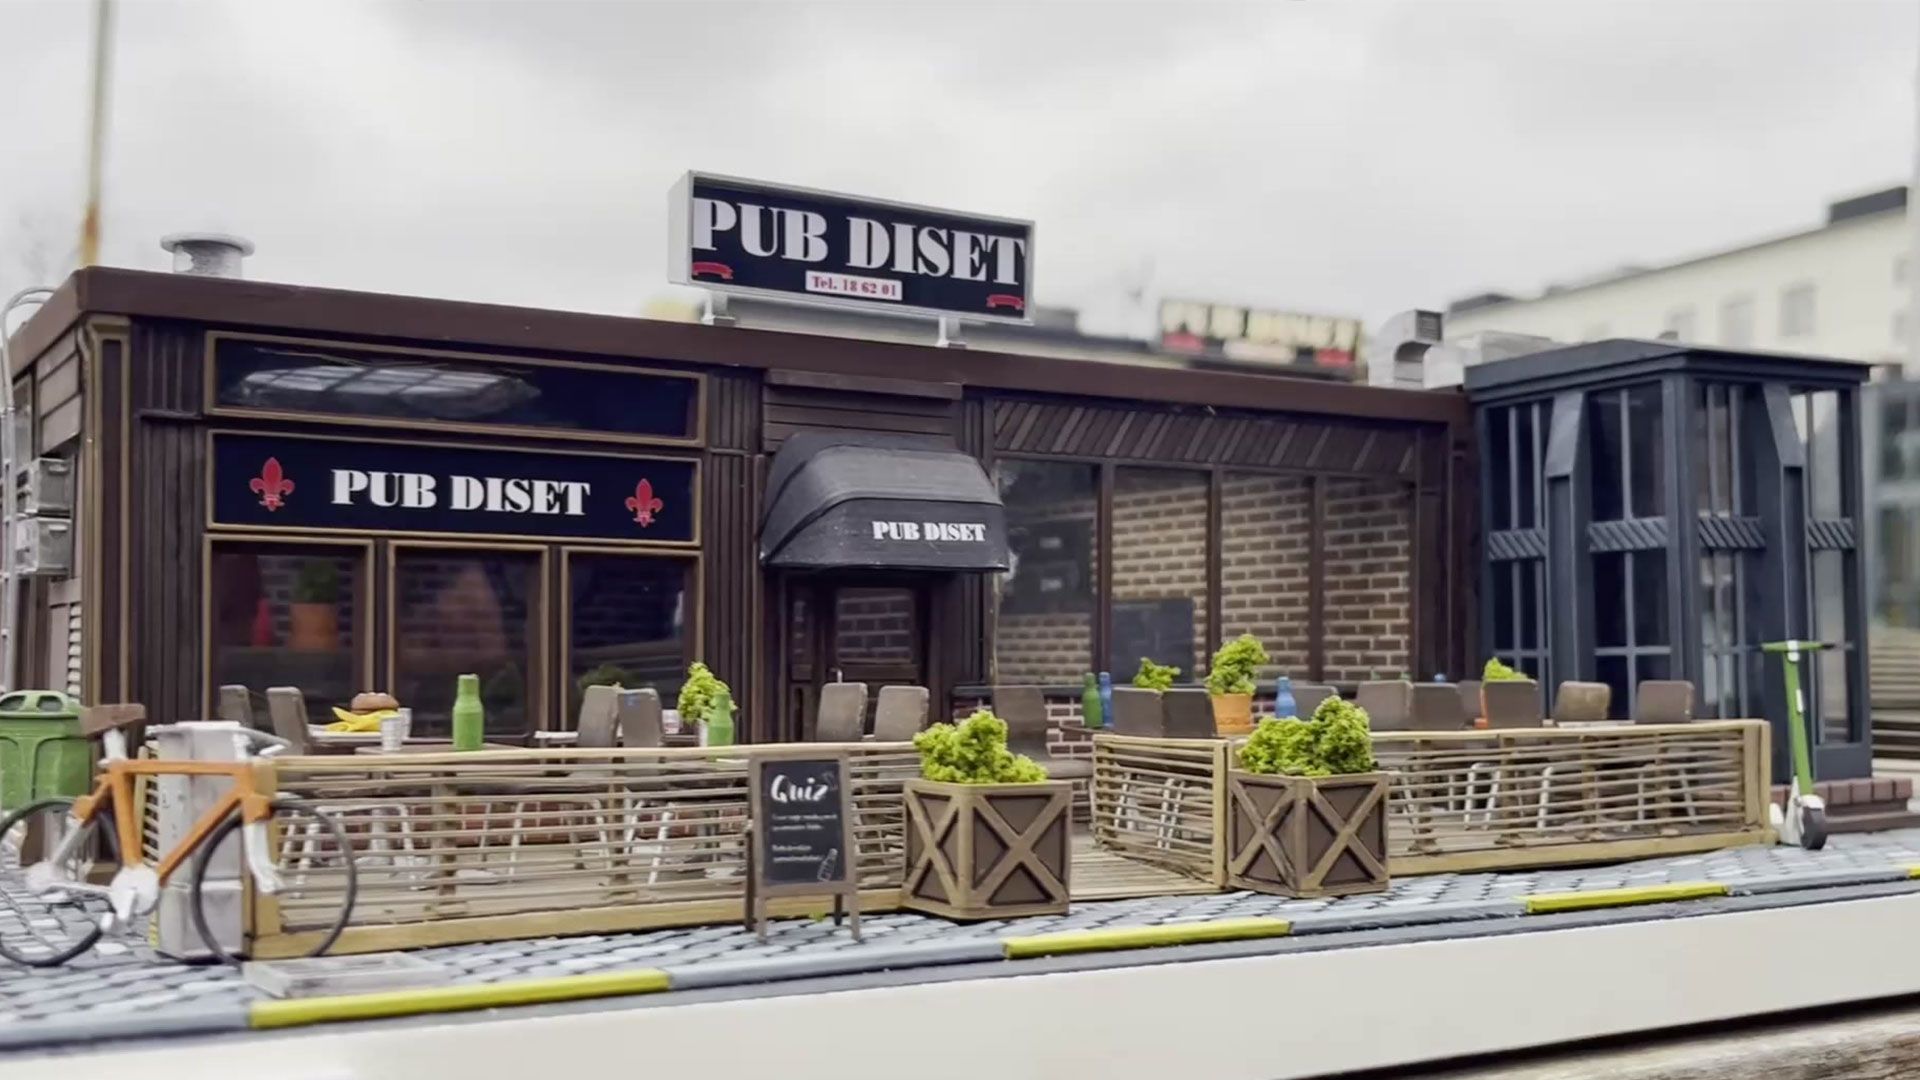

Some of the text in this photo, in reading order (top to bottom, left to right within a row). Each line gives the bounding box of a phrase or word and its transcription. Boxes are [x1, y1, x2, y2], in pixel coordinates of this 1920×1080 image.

[692, 198, 1025, 285] PUB DISET
[812, 276, 896, 296] Tel. 18 62 01
[331, 469, 591, 515] PUB DISET
[872, 521, 986, 541] PUB DISET
[771, 774, 828, 803] Quiz
